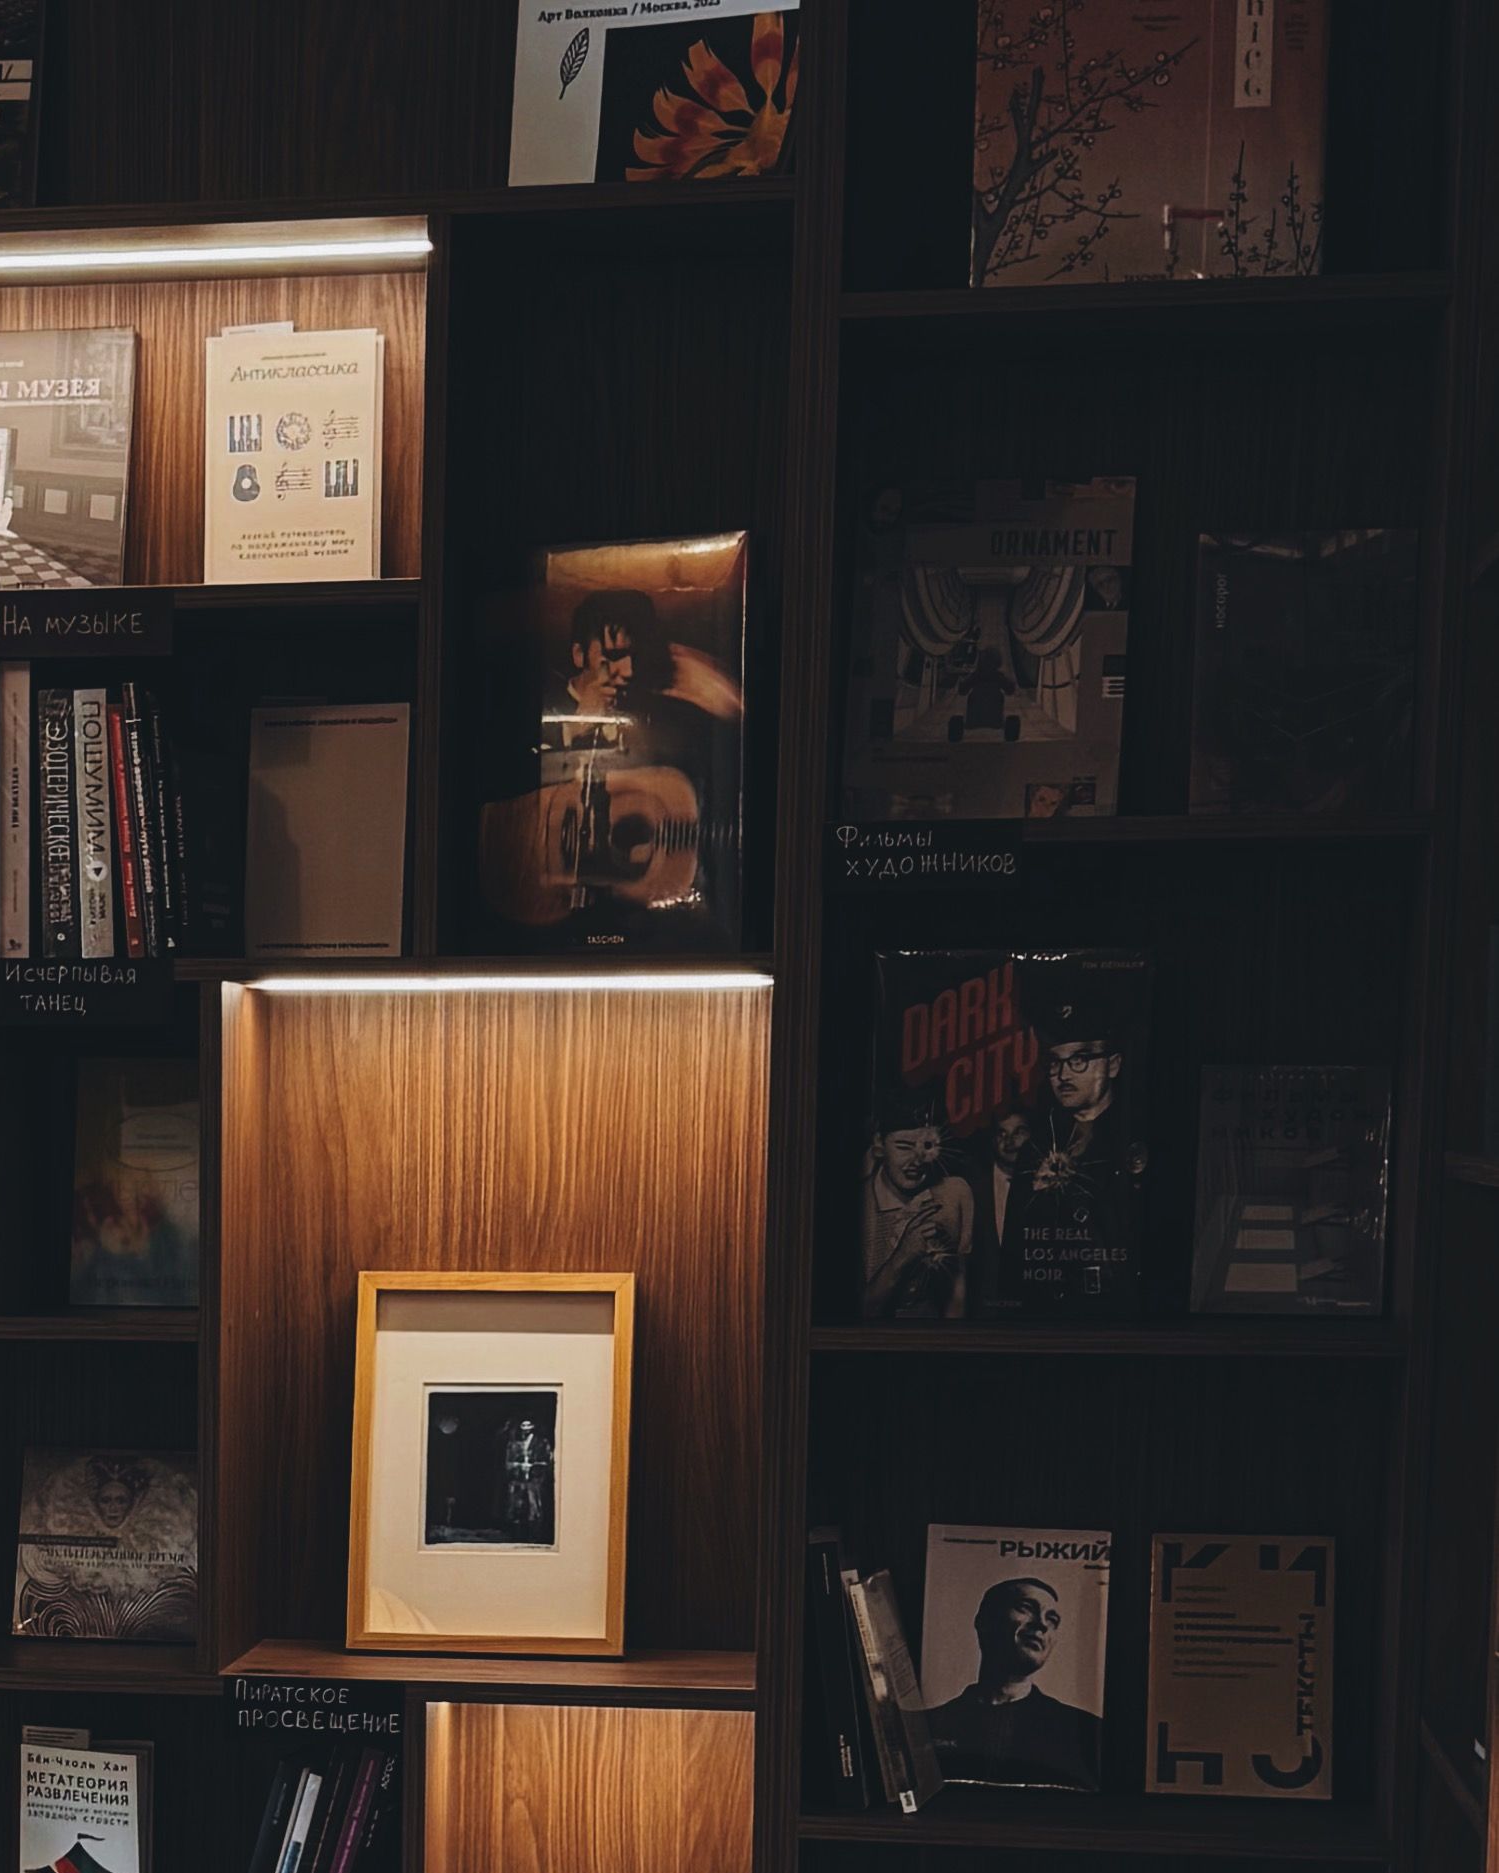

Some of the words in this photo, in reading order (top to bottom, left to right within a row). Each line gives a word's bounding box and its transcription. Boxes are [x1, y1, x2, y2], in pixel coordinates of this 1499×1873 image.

[537, 10, 562, 23] Арт
[16, 378, 102, 398] МУЗЕЯ
[990, 529, 1118, 557] ORNAMENT
[81, 700, 106, 854] ПОШУМИМ
[903, 962, 1014, 1073] DARK
[946, 1025, 1039, 1124] CITY
[1023, 1228, 1050, 1240] THE
[1055, 1228, 1092, 1240] REAL
[1024, 1248, 1053, 1261] LOS
[1059, 1248, 1128, 1261] ANGELES
[999, 1540, 1110, 1561] РЫЖИЙ
[103, 1761, 128, 1772] Хан
[27, 1770, 129, 1792] МЕТАТЕОРИЯ
[27, 1785, 130, 1806] РАЗВЛЕЧЕНИЯ
